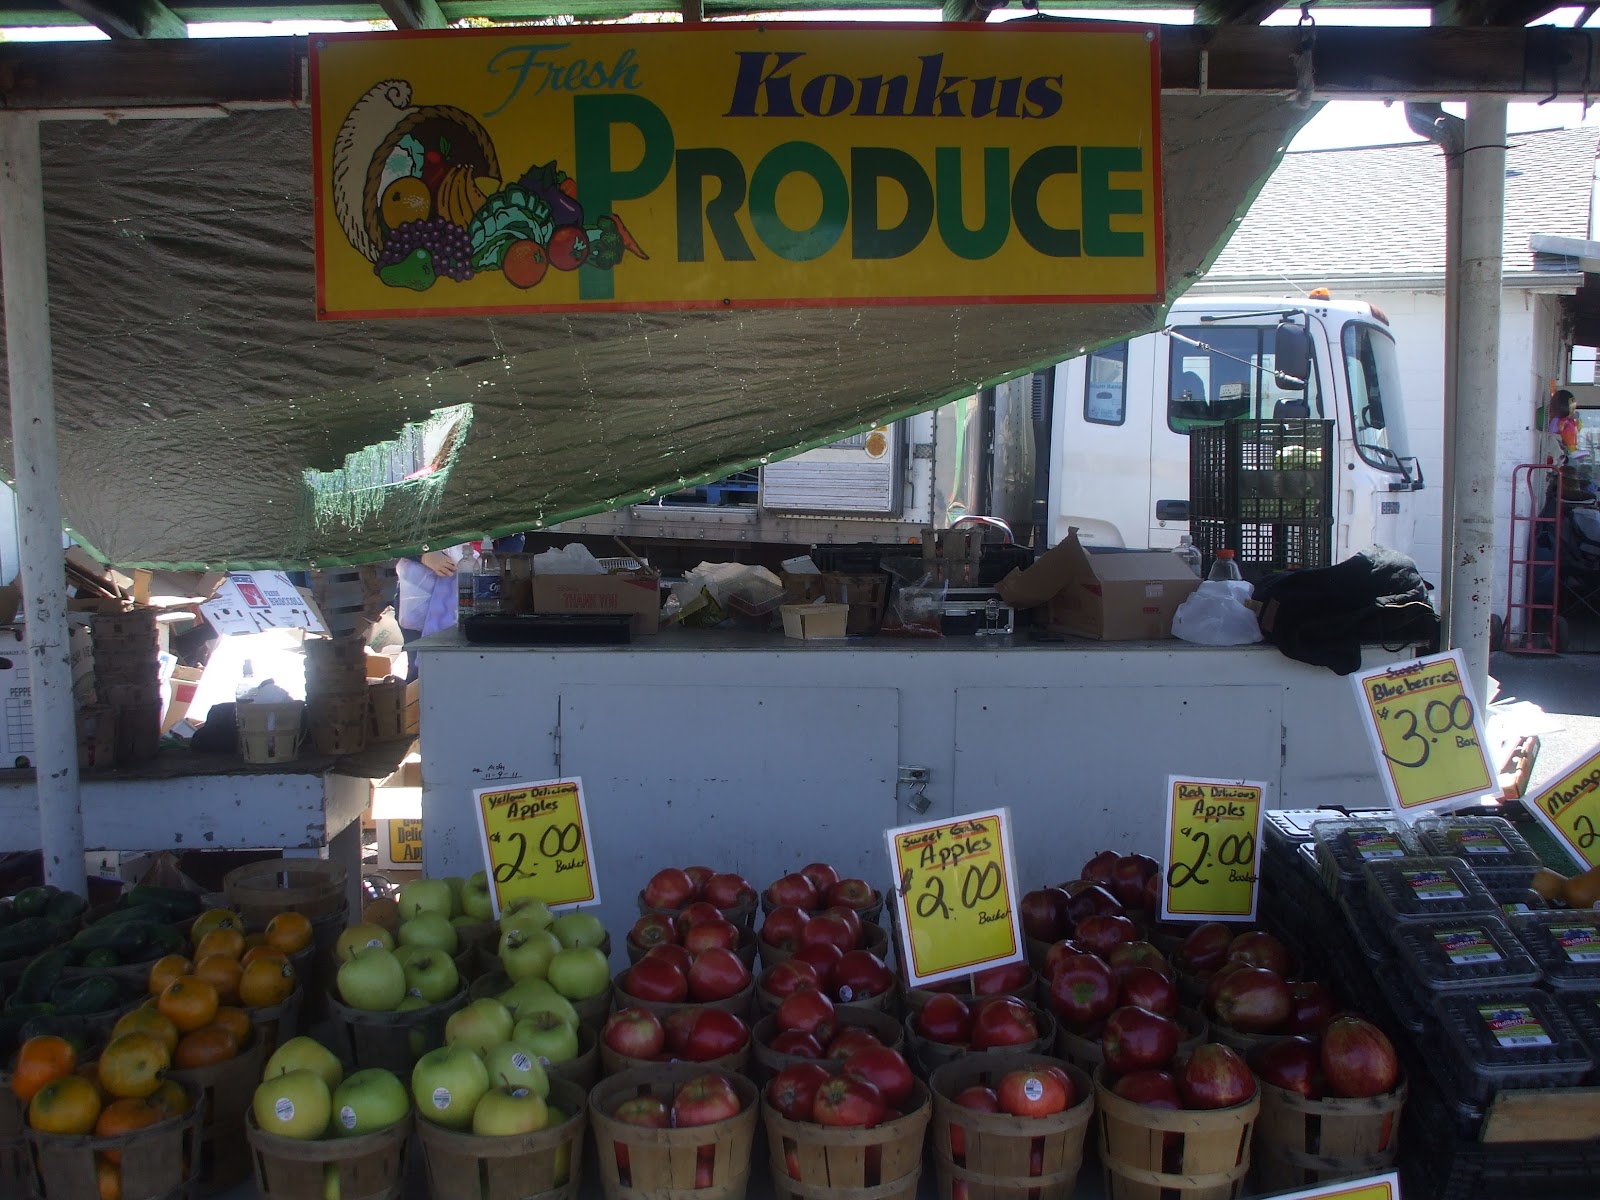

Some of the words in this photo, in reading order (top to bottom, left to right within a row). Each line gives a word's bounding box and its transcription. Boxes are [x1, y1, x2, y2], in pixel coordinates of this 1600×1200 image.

[483, 42, 643, 118] Fresh
[722, 51, 1064, 120] Konkus
[573, 93, 1144, 300] PRODUCE
[268, 597, 305, 606] BROCCOLI
[562, 592, 597, 609] THANK
[599, 592, 618, 609] YOU
[1455, 735, 1480, 748] Box
[488, 792, 527, 810] Yellow
[531, 785, 580, 799] Delicious
[1179, 785, 1205, 799] Red
[507, 799, 558, 820] Apples
[1192, 799, 1245, 823] Apples
[902, 829, 942, 848] Sweet
[949, 820, 988, 836] Gala
[920, 837, 992, 871] Apples
